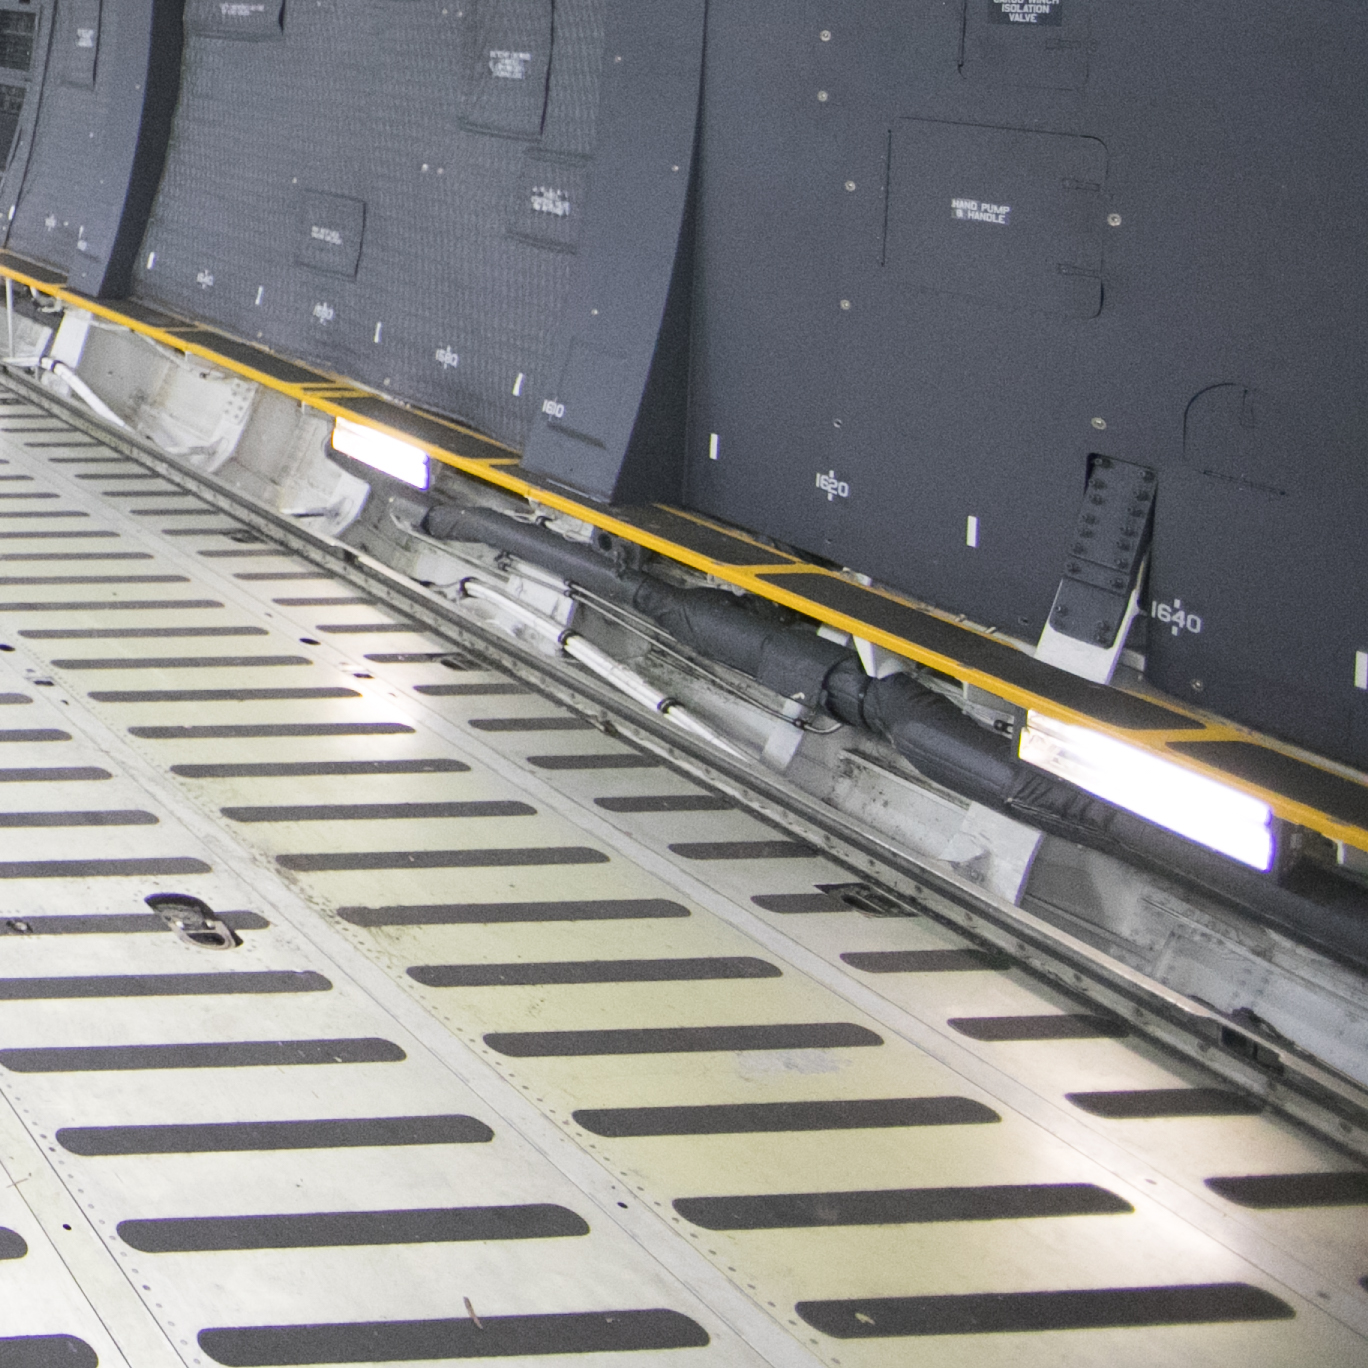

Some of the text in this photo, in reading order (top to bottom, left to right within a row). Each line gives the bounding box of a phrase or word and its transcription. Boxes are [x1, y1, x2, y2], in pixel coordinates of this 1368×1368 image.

[1002, 4, 1050, 14] ISOLATION
[1009, 13, 1037, 22] VALVE
[951, 198, 1011, 214] HAND PUMP
[968, 210, 1006, 224] HANDLE
[815, 472, 849, 498] 1620
[1151, 600, 1202, 634] 1640
